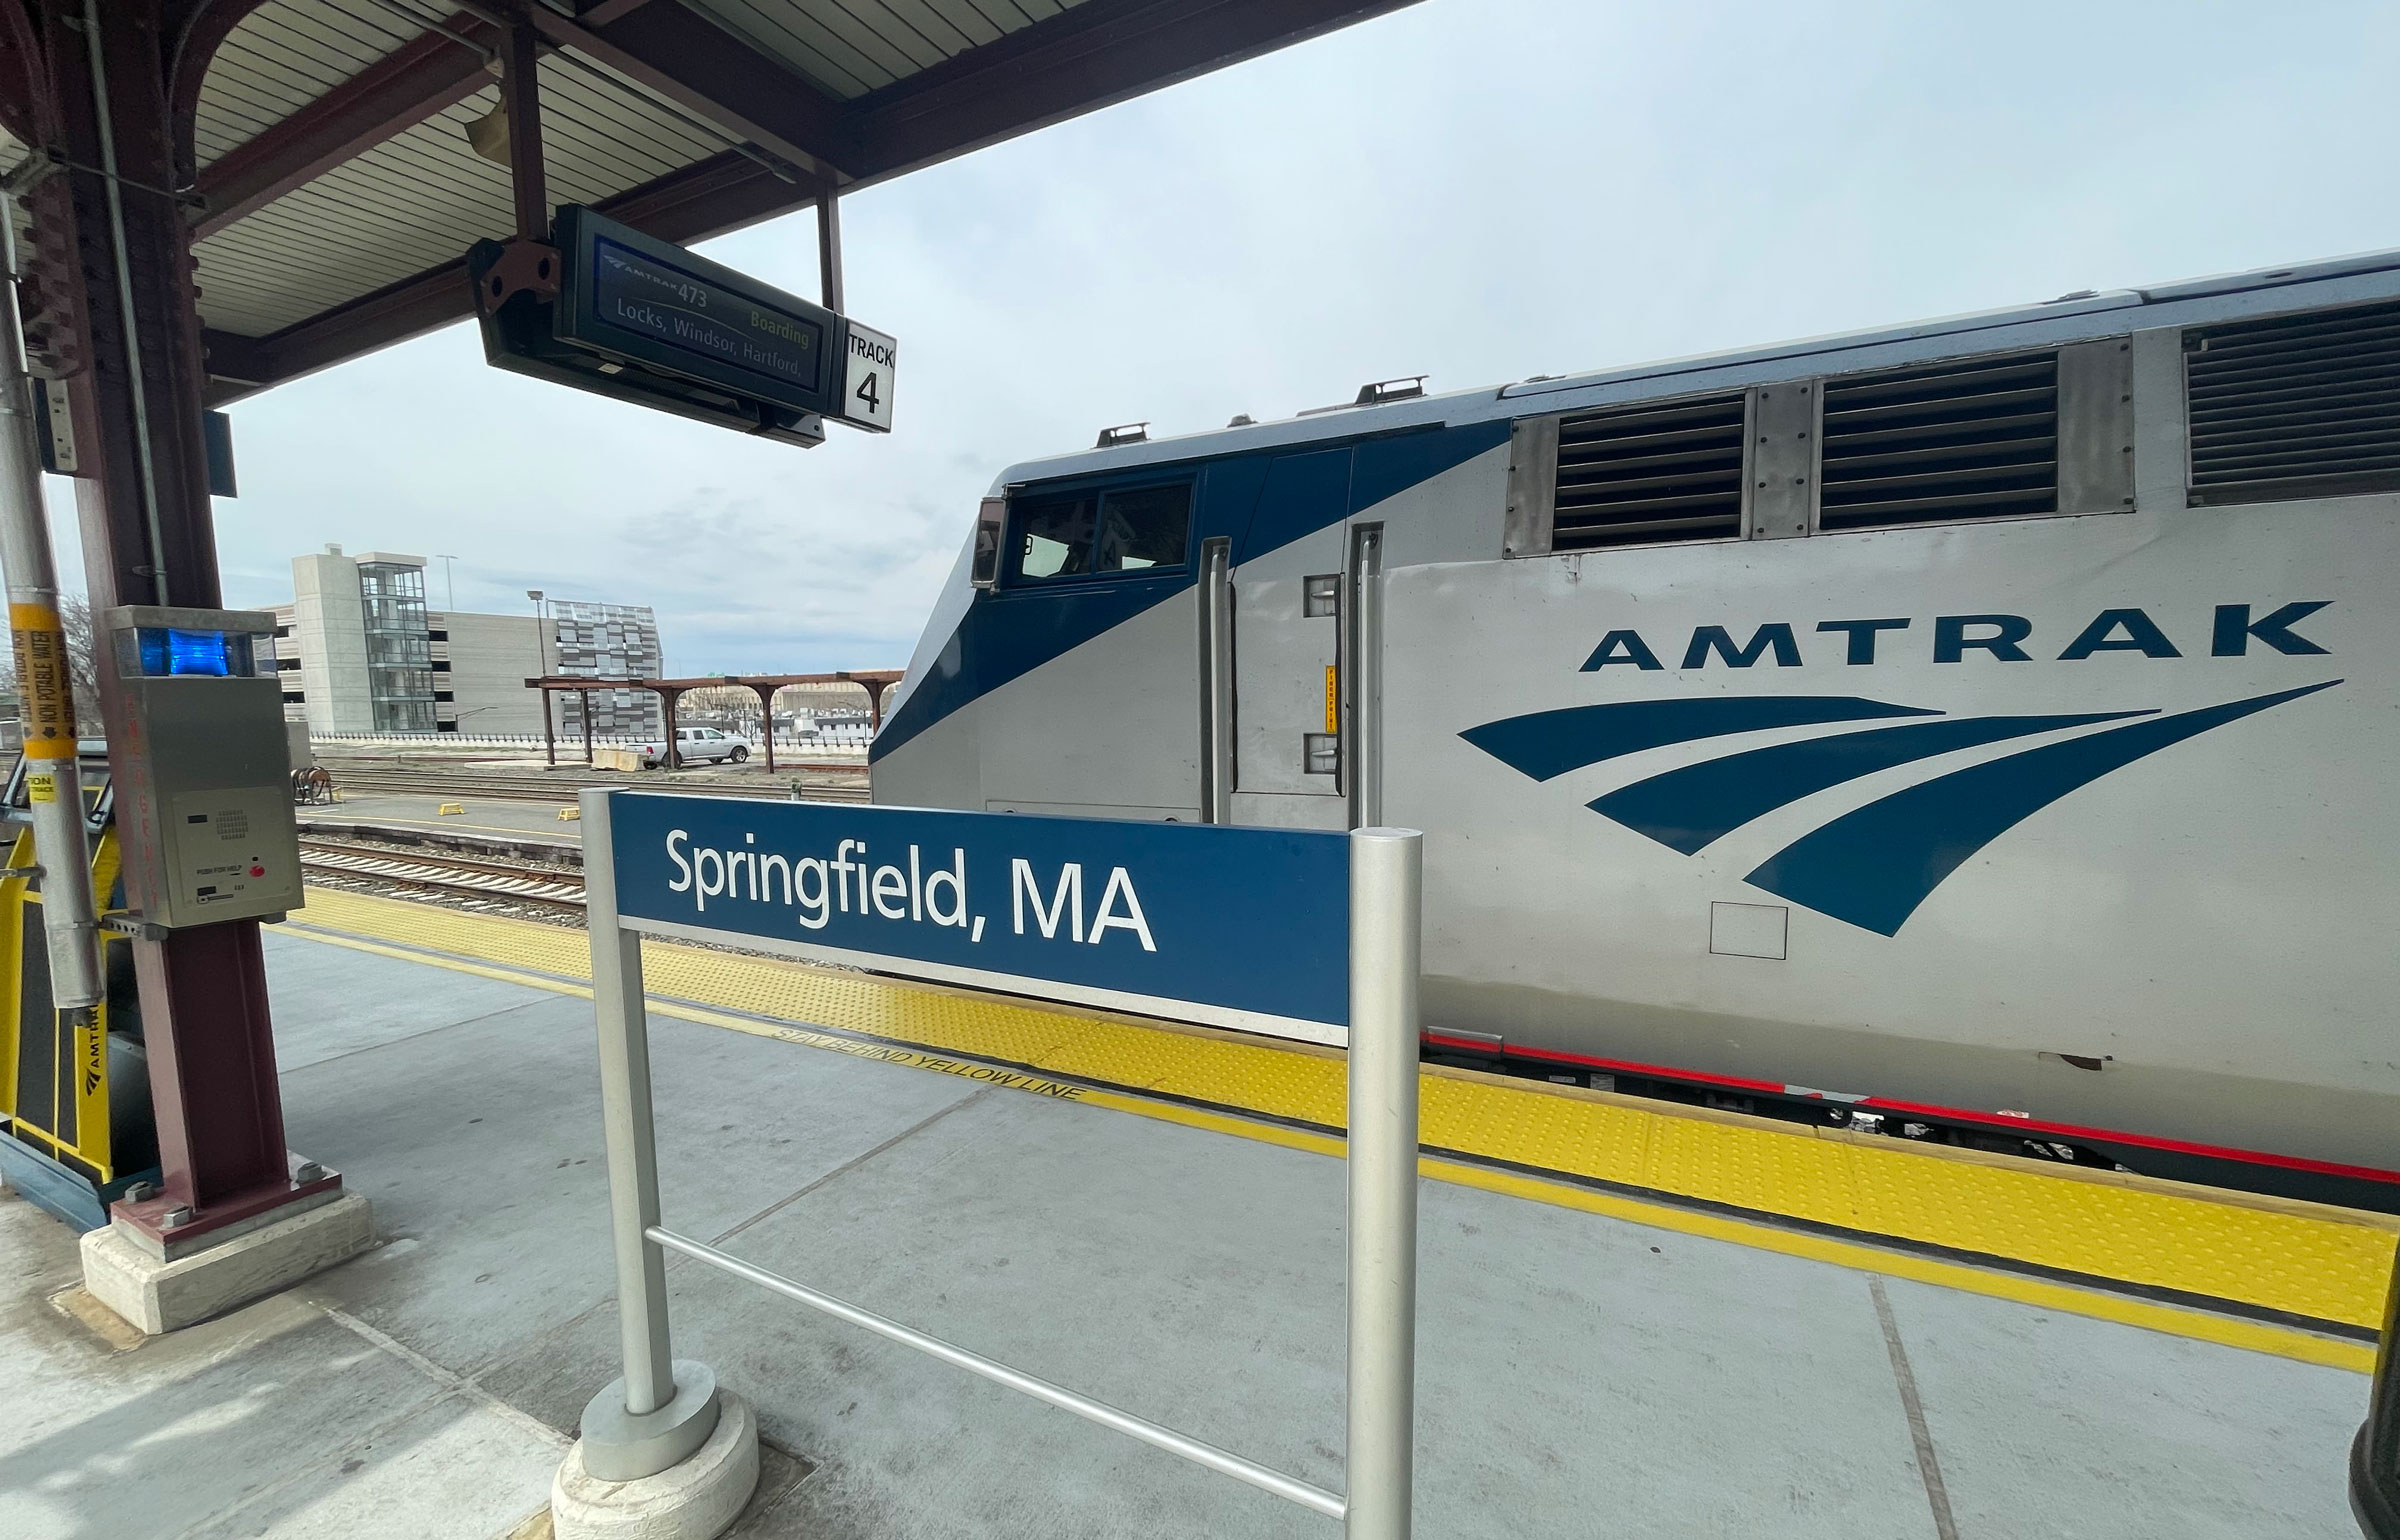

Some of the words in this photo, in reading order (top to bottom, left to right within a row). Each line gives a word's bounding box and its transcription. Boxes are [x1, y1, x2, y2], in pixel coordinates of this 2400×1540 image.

[624, 265, 678, 290] AMTRAK
[678, 282, 708, 308] 473
[617, 298, 668, 334] Locks,
[674, 317, 738, 356] Windsor,
[751, 311, 809, 350] Boarding
[849, 333, 894, 368] TRACK
[857, 372, 880, 414] 4
[31, 631, 51, 659] WATER
[1578, 601, 2335, 672] AMTRAK
[34, 663, 56, 700] POTABLE
[39, 704, 57, 723] NON
[666, 829, 986, 944] Springfield,
[1012, 858, 1157, 952] MA
[90, 1004, 100, 1068] AMTRA
[771, 1028, 826, 1047] STAY
[825, 1037, 913, 1064] BEHIND
[914, 1056, 1022, 1086] YELLOW
[1018, 1078, 1088, 1101] LINE
